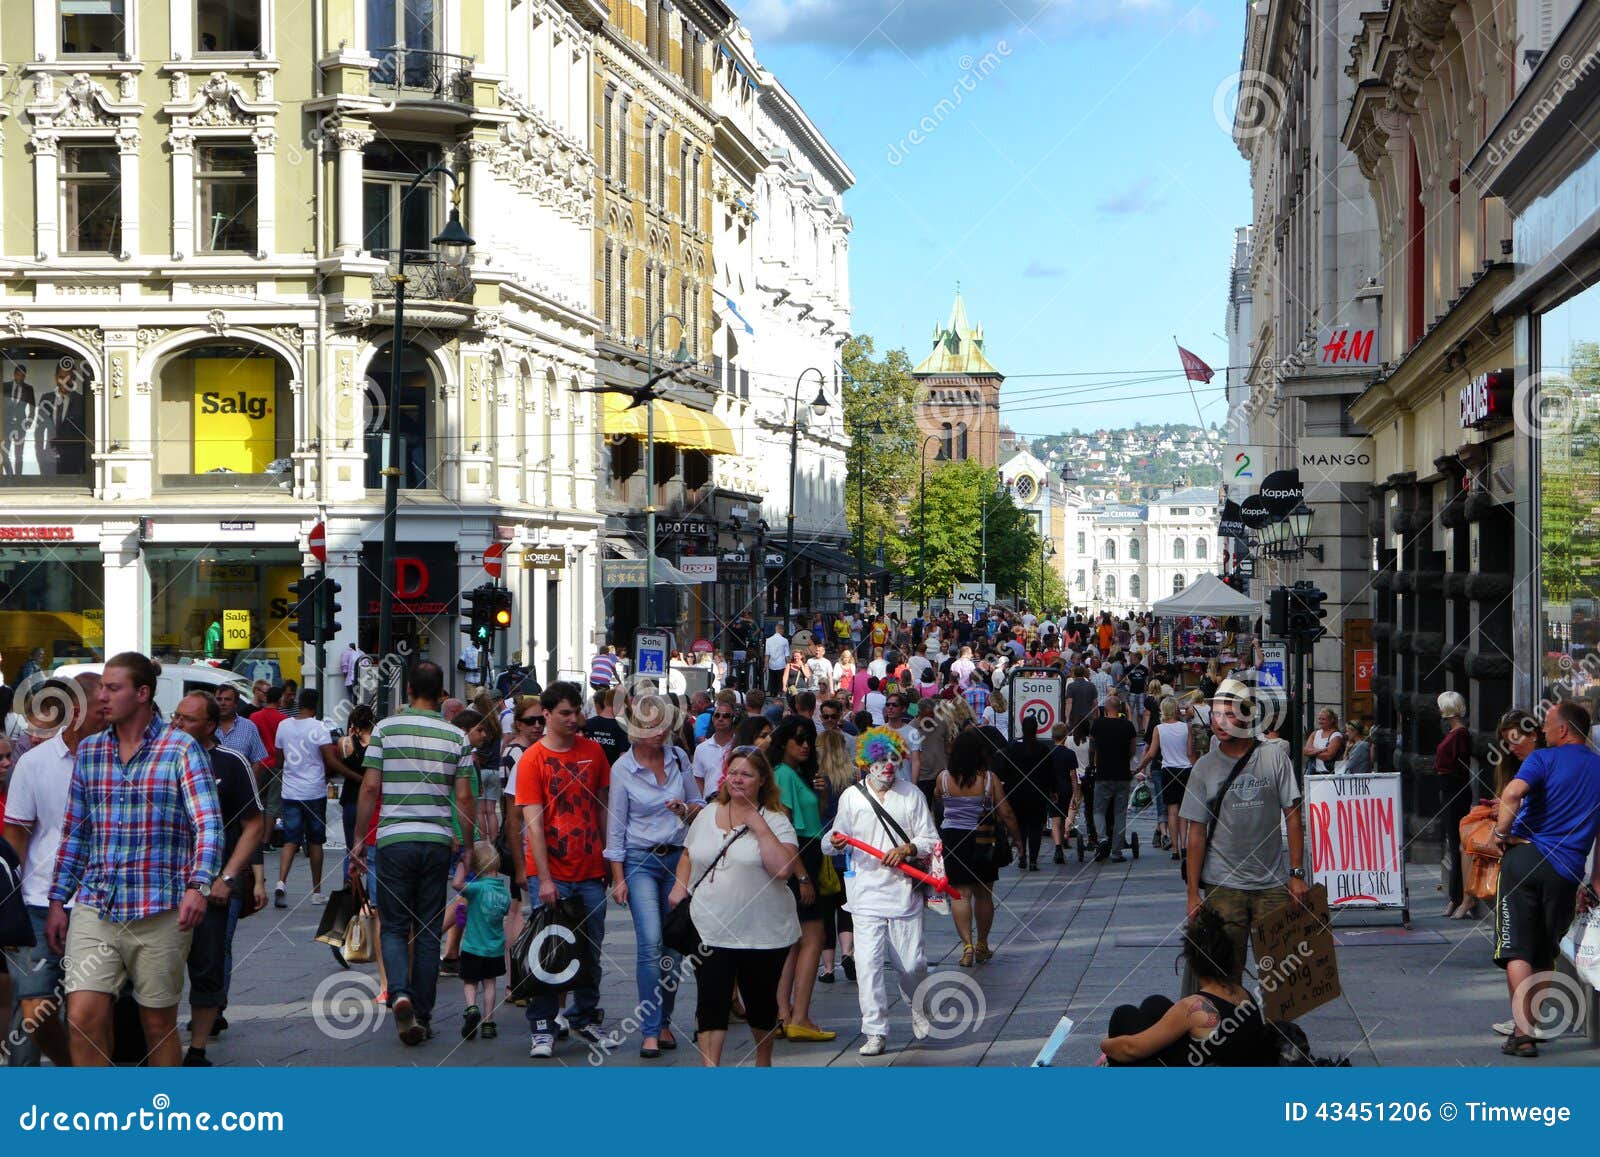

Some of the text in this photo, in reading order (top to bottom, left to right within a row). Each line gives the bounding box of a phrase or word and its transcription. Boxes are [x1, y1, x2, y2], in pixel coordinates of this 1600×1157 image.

[1322, 330, 1374, 364] H&M
[1235, 452, 1253, 478] 2
[1302, 454, 1371, 466] MANGO
[1241, 507, 1269, 516] KappA
[656, 522, 705, 533] APOTEK
[958, 592, 983, 601] NCC
[225, 612, 248, 623] Salg
[1022, 681, 1053, 693] Sone
[1309, 801, 1336, 873] DR
[528, 924, 581, 985] C
